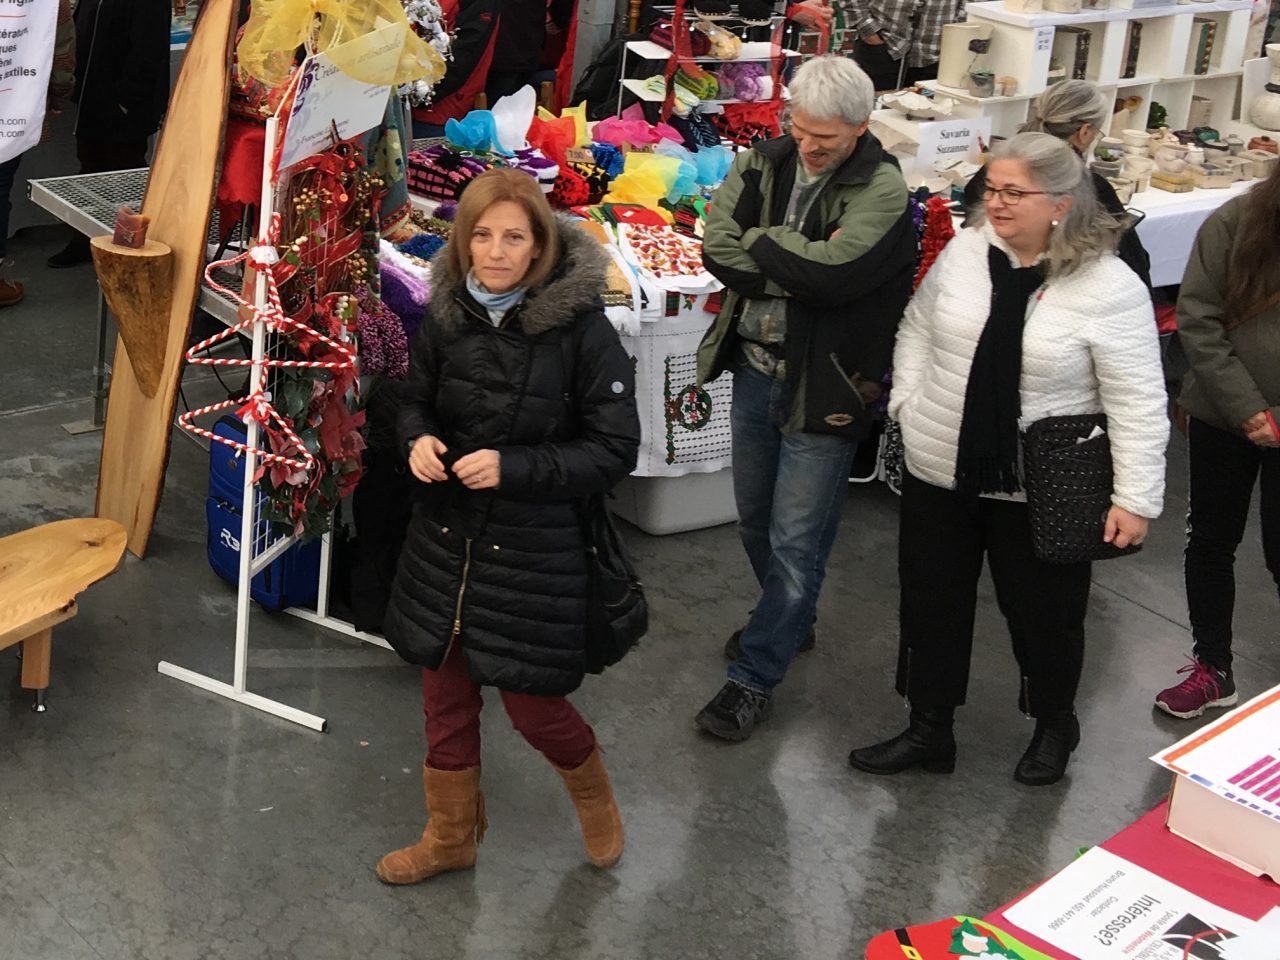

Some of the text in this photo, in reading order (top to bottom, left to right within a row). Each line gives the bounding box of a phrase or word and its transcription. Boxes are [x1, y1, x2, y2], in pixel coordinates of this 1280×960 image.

[4, 66, 37, 80] extiles
[940, 128, 970, 140] Savaria
[936, 144, 969, 155] Suzanne
[1093, 894, 1162, 947] Intéressé?
